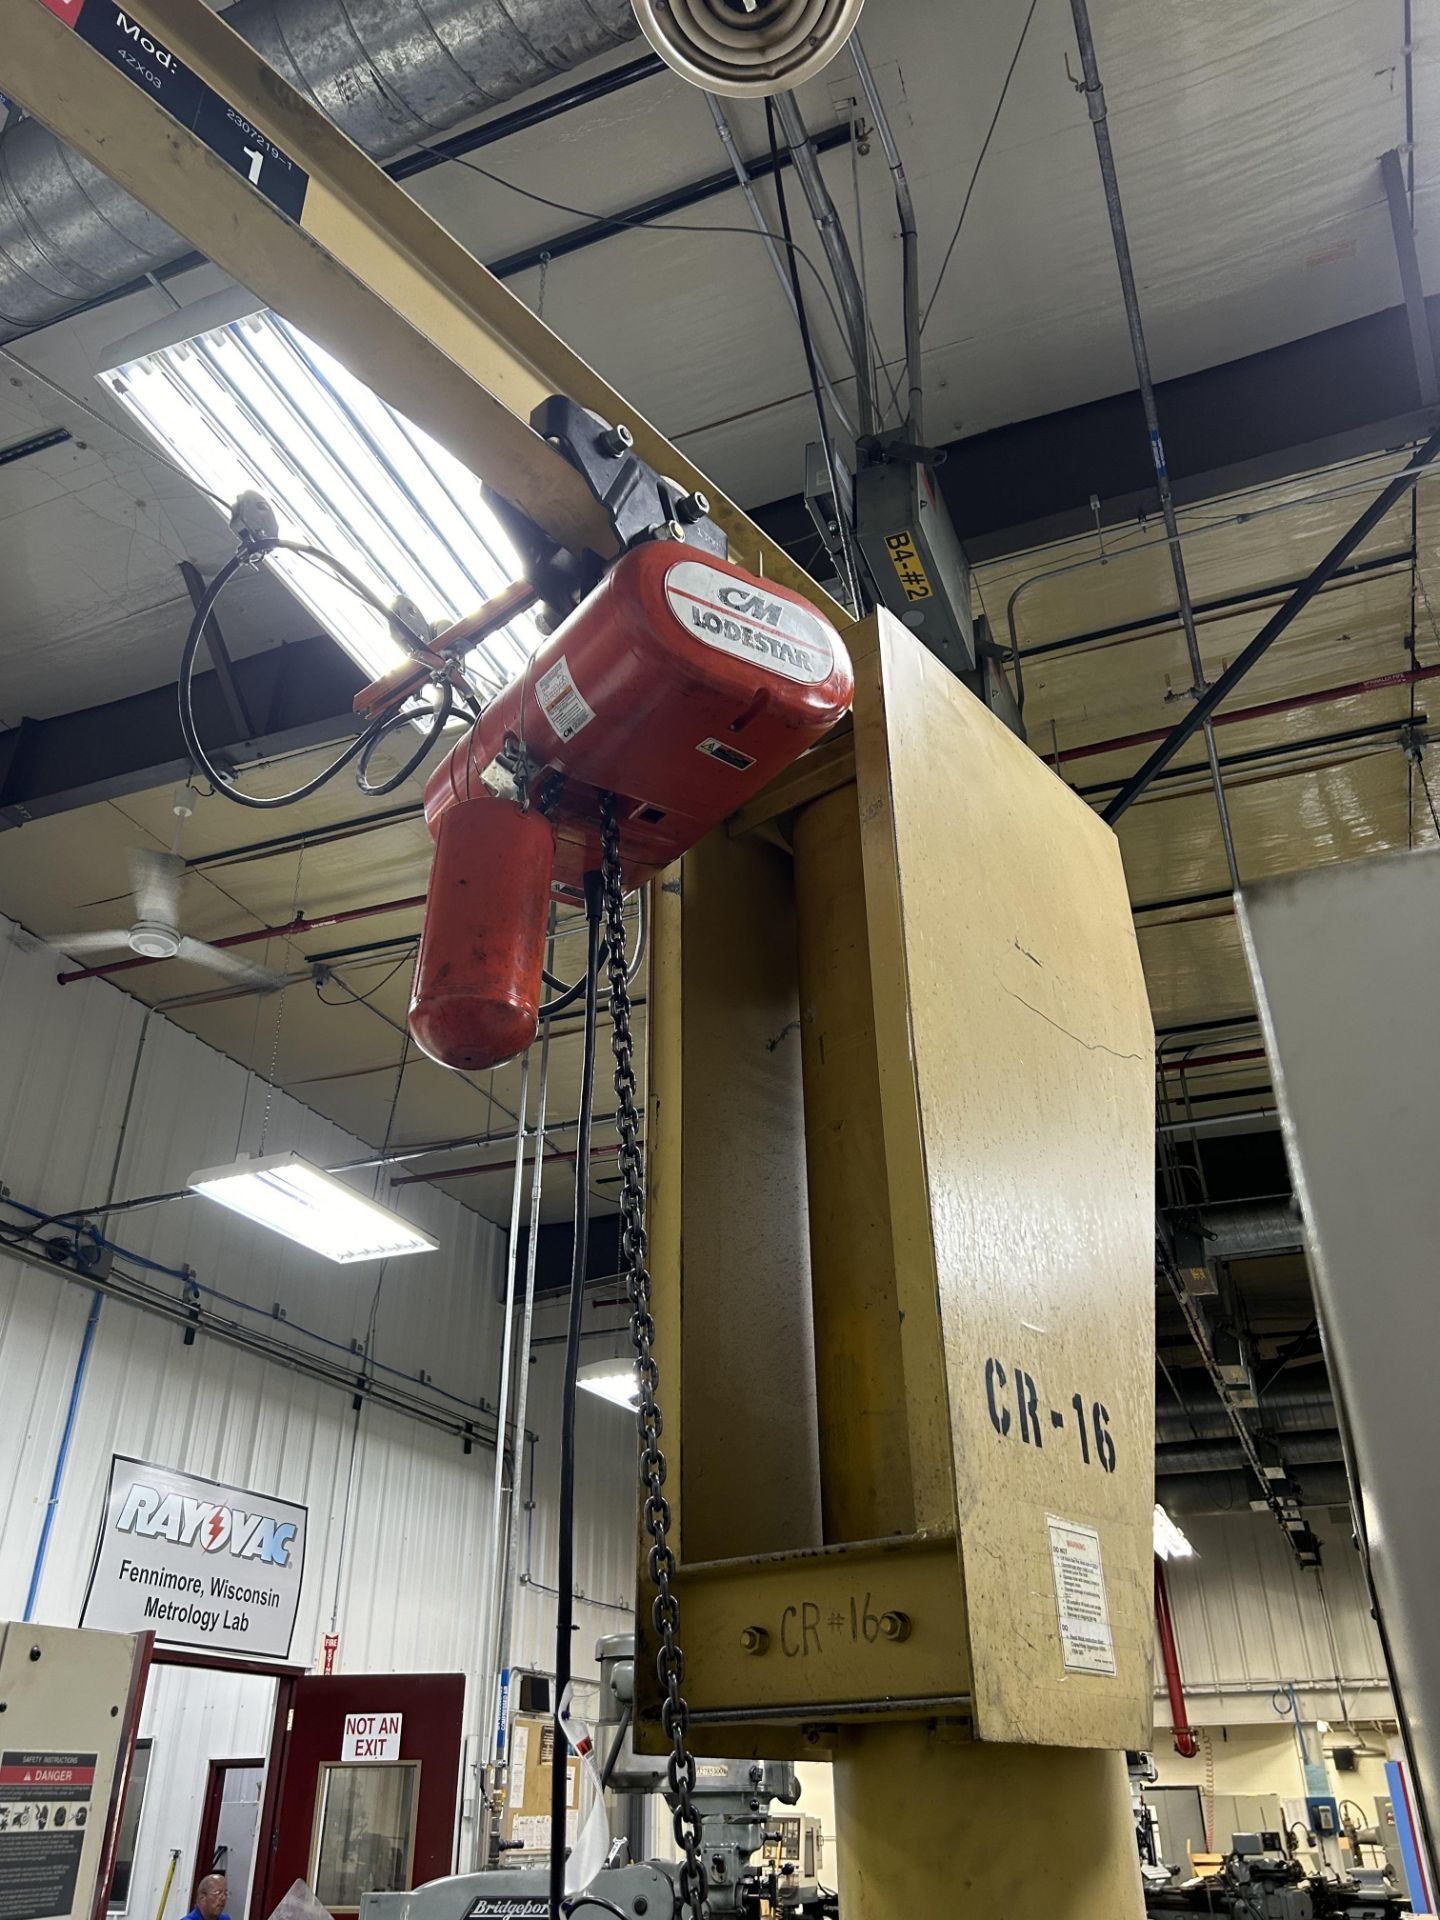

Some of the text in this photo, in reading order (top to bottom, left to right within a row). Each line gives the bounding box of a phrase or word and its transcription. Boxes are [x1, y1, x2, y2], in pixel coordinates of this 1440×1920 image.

[116, 12, 178, 74] Mod:
[118, 49, 162, 89] 4ZX03
[226, 108, 292, 171] 2307219-1
[243, 145, 264, 186] 1
[885, 531, 929, 601] B4-#2
[717, 586, 784, 627] CM
[691, 605, 814, 673] LODESTAR
[984, 1357, 1116, 1473] CR-16
[115, 1483, 298, 1568] RAYOVAC
[119, 1559, 280, 1608] Fennimore, Wisconsin
[144, 1596, 249, 1632] Metrology Lab
[346, 1717, 399, 1735] NOT AN
[22, 1755, 42, 1764] SAFETY
[355, 1739, 387, 1756] EXIT
[35, 1770, 72, 1781] DANGER
[473, 1900, 551, 1920] Bridgepor
